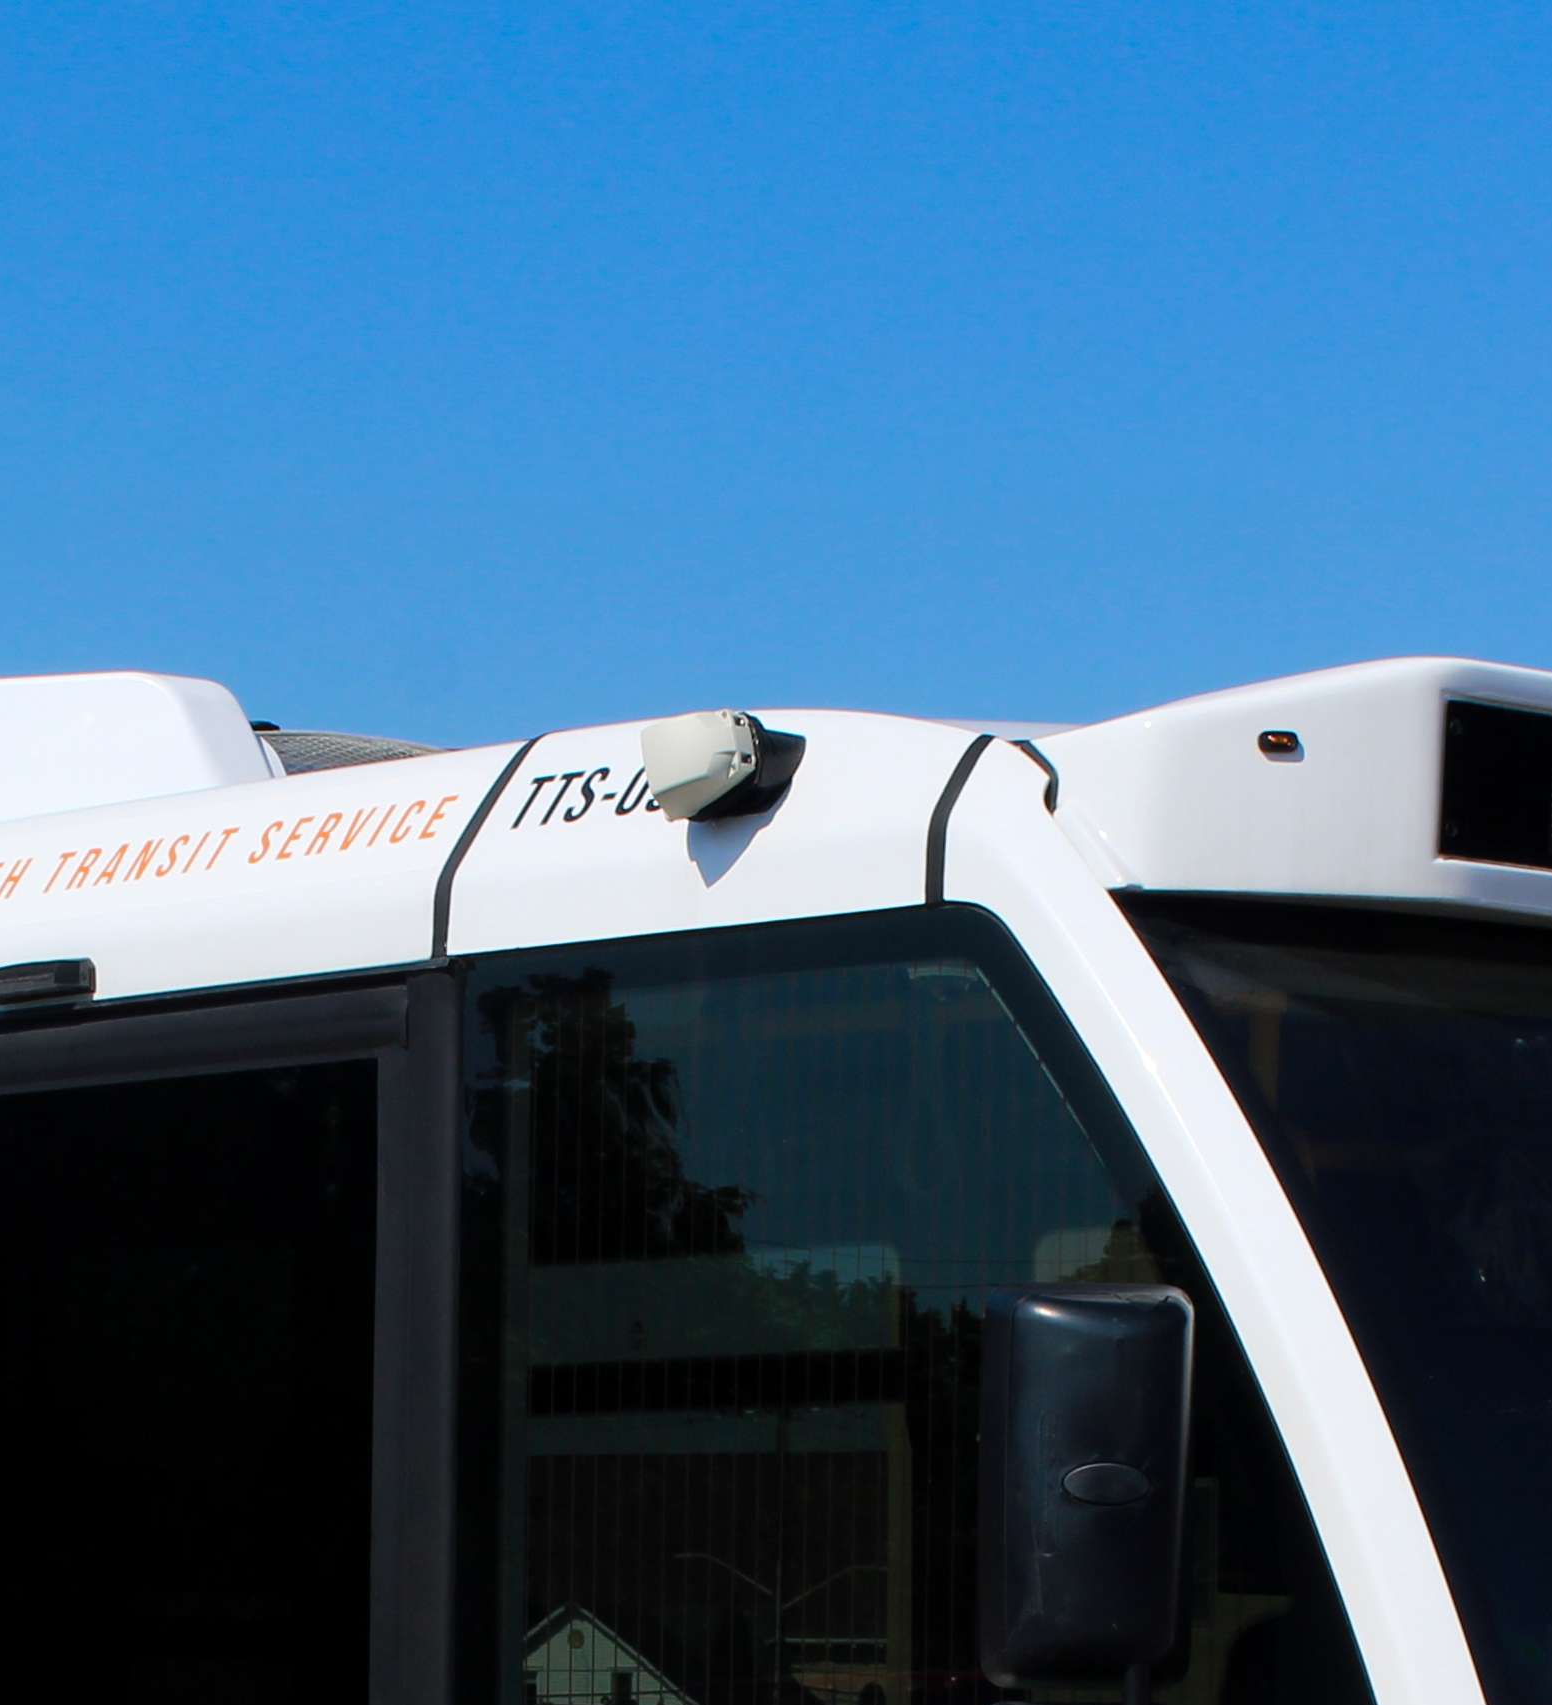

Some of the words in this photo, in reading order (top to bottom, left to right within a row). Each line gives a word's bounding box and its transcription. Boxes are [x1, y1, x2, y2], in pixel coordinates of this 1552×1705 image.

[511, 767, 660, 829] TTS-0
[44, 827, 240, 895] TRANSIT
[247, 795, 459, 865] SERVICE
